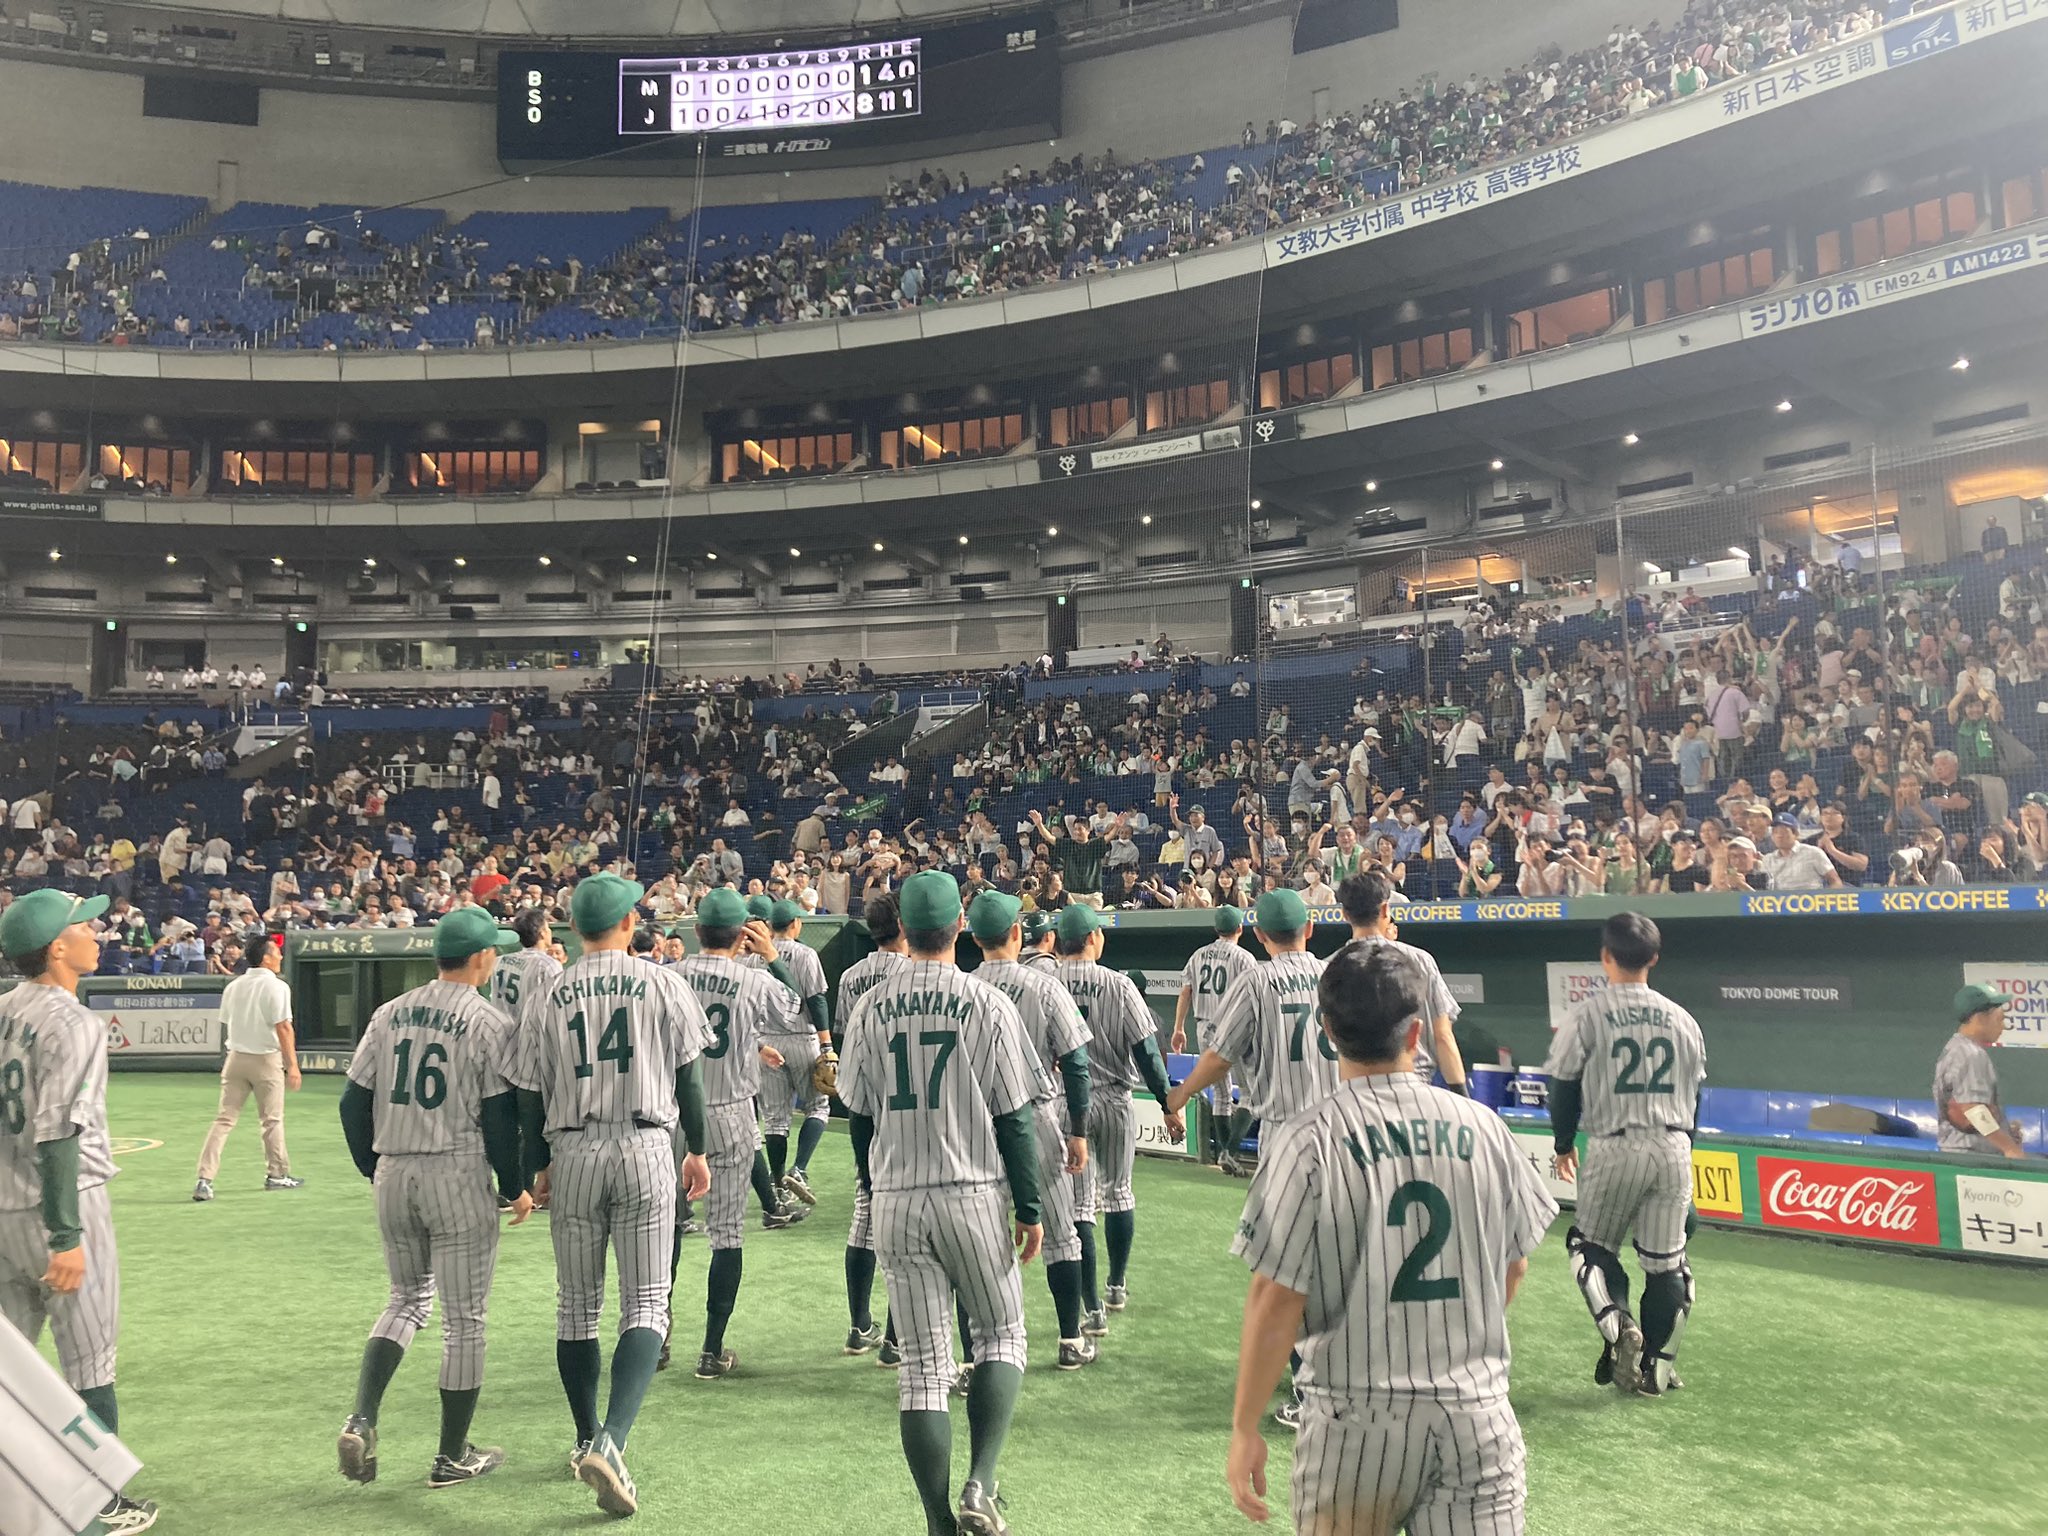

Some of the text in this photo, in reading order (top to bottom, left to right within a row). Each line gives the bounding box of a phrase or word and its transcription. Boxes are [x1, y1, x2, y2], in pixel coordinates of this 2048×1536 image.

[679, 41, 912, 72] 1 2 3 4 5 6 7 8 9 R H E
[528, 71, 542, 87] B
[676, 80, 689, 96] 0
[700, 79, 708, 95] 1
[717, 78, 730, 95] 0
[737, 77, 749, 93] 0
[757, 76, 769, 92] 0
[777, 75, 789, 90] 0
[797, 73, 810, 89] 0
[817, 71, 830, 88] 0
[837, 69, 850, 86] 0
[860, 63, 871, 86] 1
[877, 61, 895, 82] 4
[898, 59, 916, 79] 0
[1722, 41, 1877, 116] 新日本空調
[528, 88, 542, 105] S
[644, 87, 914, 125] J 1 0 0 4 1 0 2 0 X 8 11 1
[1277, 145, 1583, 259] 文教大学付属 中学校 高等学校
[1873, 266, 1939, 295] FM92.4
[1950, 242, 2026, 276] AM1422
[3, 500, 98, 512] www.giants-seat.jp
[126, 977, 183, 990] KONAMI
[496, 968, 521, 1005] 15
[552, 974, 648, 1009] ICHIKAWA
[1198, 963, 1228, 996] 20
[1268, 973, 1320, 996] YAMAM
[1568, 975, 1610, 989] TOKY
[1720, 986, 1840, 1001] TOKYO DOME TOUR
[873, 990, 973, 1026] TAKAYAMA
[1605, 1005, 1674, 1031] KUSABE
[140, 1018, 208, 1045] LaKeel
[567, 1006, 634, 1079] 14
[389, 1037, 449, 1111] 16
[888, 1030, 958, 1111] 17
[1610, 1036, 1676, 1095] 22
[1341, 1118, 1476, 1171] KANEKO
[1769, 1167, 1925, 1233] Coca-Cola
[1964, 1188, 2000, 1203] Kyorin
[1386, 1180, 1461, 1302] 2
